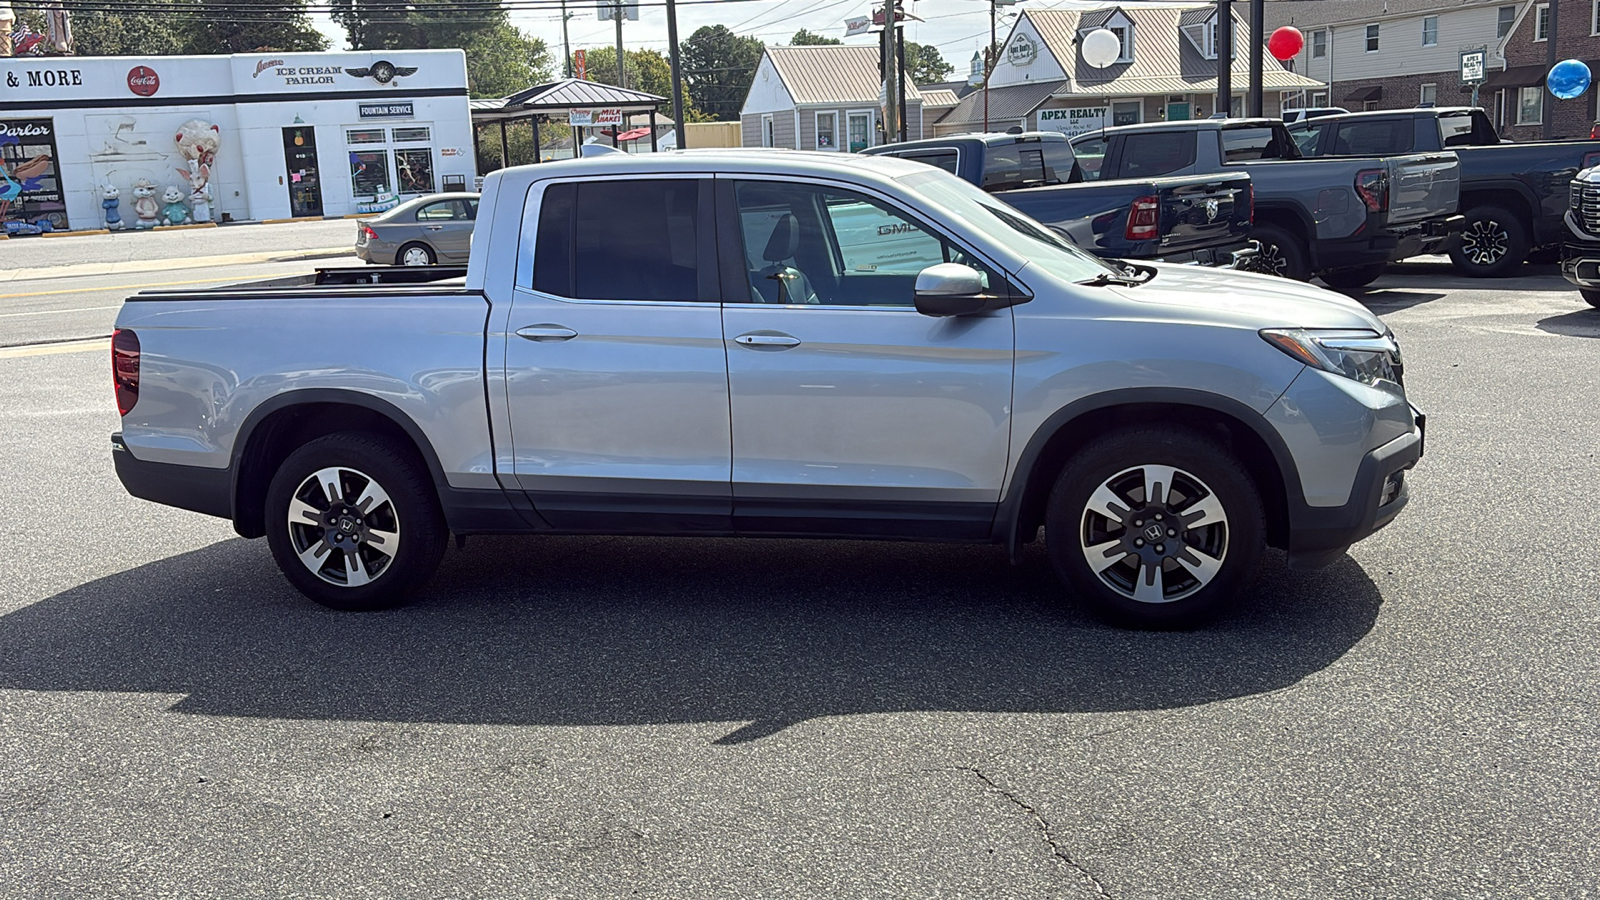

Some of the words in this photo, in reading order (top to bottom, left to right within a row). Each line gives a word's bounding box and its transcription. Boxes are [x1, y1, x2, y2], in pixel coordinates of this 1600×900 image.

[276, 67, 297, 76] ICE
[299, 66, 342, 75] CREAM
[6, 71, 19, 87] &
[27, 69, 82, 87] MORE
[285, 76, 335, 86] PARLOR
[361, 106, 389, 115] FOUNTAIN
[389, 105, 412, 114] SERVICE
[601, 108, 621, 116] MILK
[1041, 110, 1067, 120] APEX
[1070, 108, 1107, 119] REALTY
[597, 115, 621, 123] SHAKES
